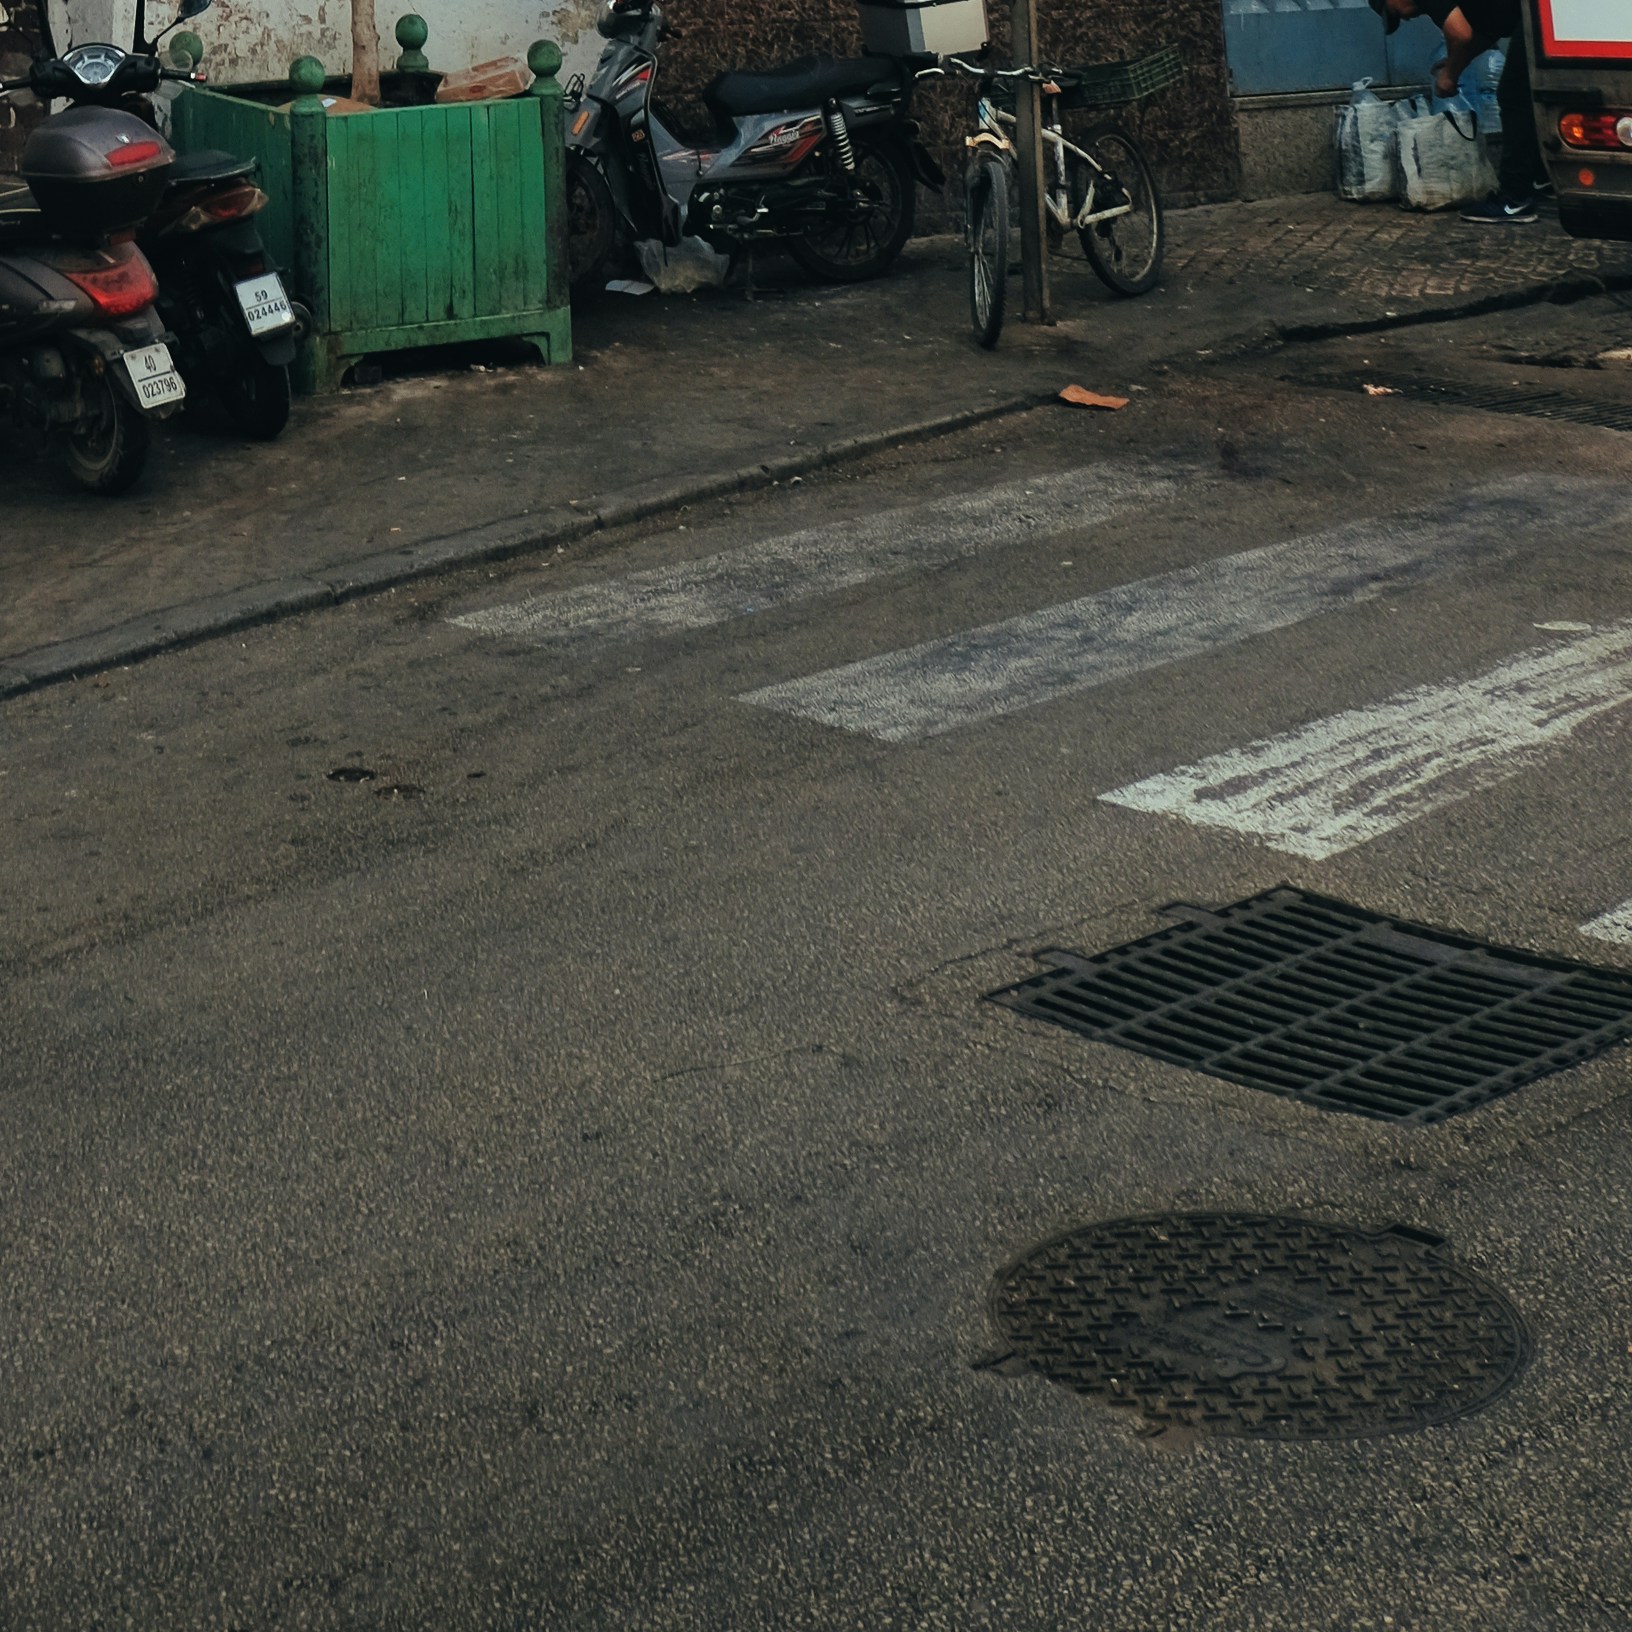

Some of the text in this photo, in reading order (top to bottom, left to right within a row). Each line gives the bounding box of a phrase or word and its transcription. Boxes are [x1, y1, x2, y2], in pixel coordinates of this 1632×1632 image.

[254, 289, 268, 303] 59
[247, 299, 287, 322] 024446
[144, 354, 157, 373] 40
[142, 376, 178, 399] 023796
